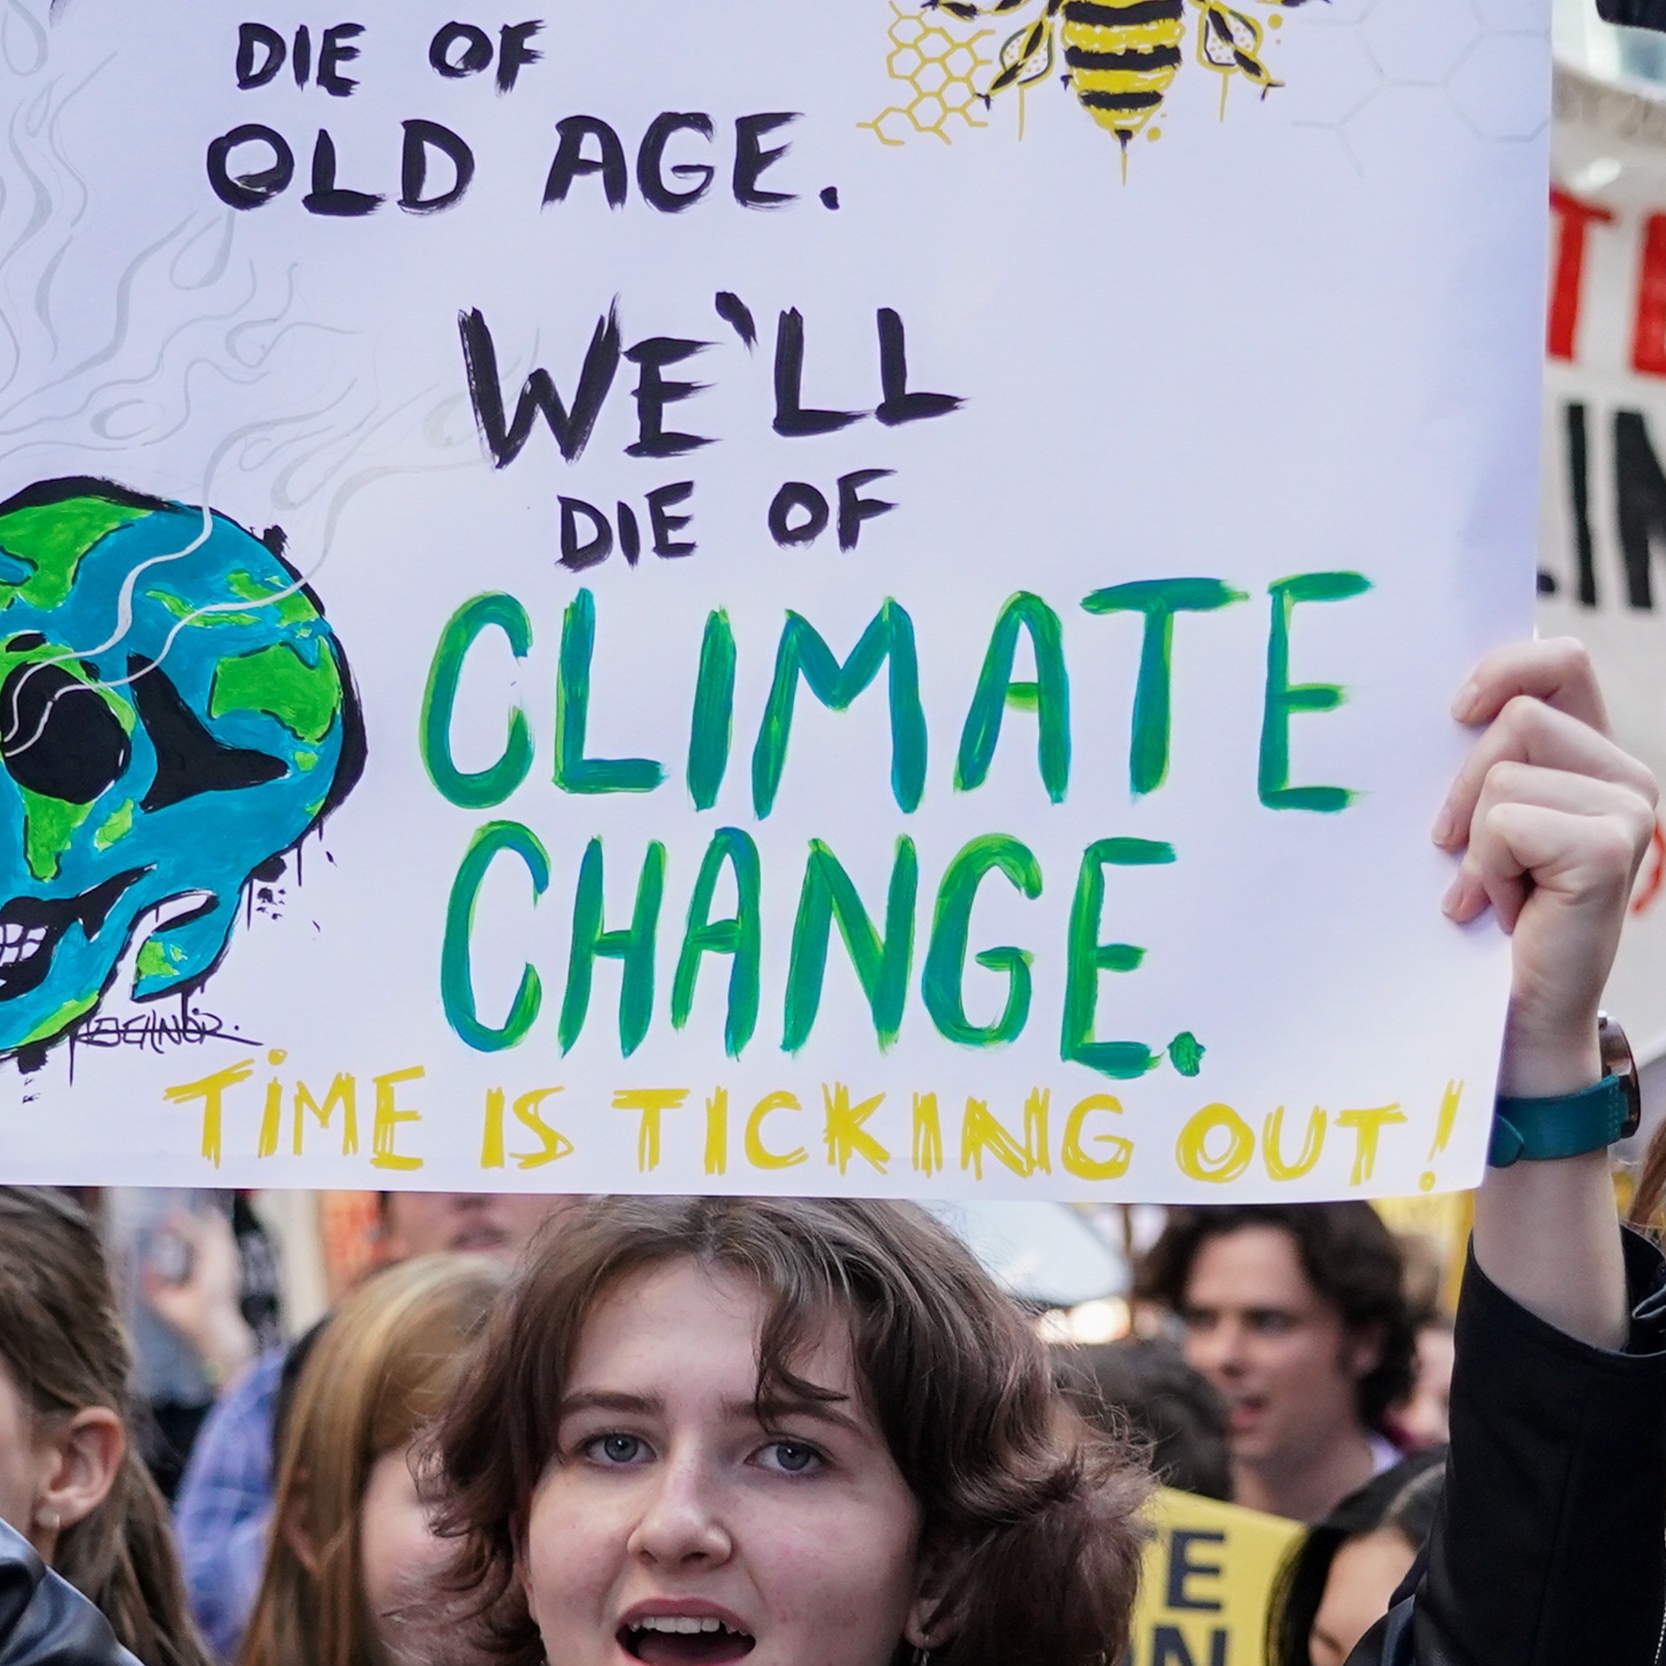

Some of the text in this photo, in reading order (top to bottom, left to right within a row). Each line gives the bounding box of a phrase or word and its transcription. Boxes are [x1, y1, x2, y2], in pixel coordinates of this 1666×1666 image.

[237, 19, 546, 97] DIE OF
[206, 111, 840, 216] OLD AGE.
[457, 291, 967, 471] WE'LL
[556, 468, 897, 571] DIE OF
[419, 571, 1373, 820] CLIMATE
[440, 820, 1206, 1080] CHANGE.
[164, 1048, 1463, 1192] TIME IS TICKING OUT!
